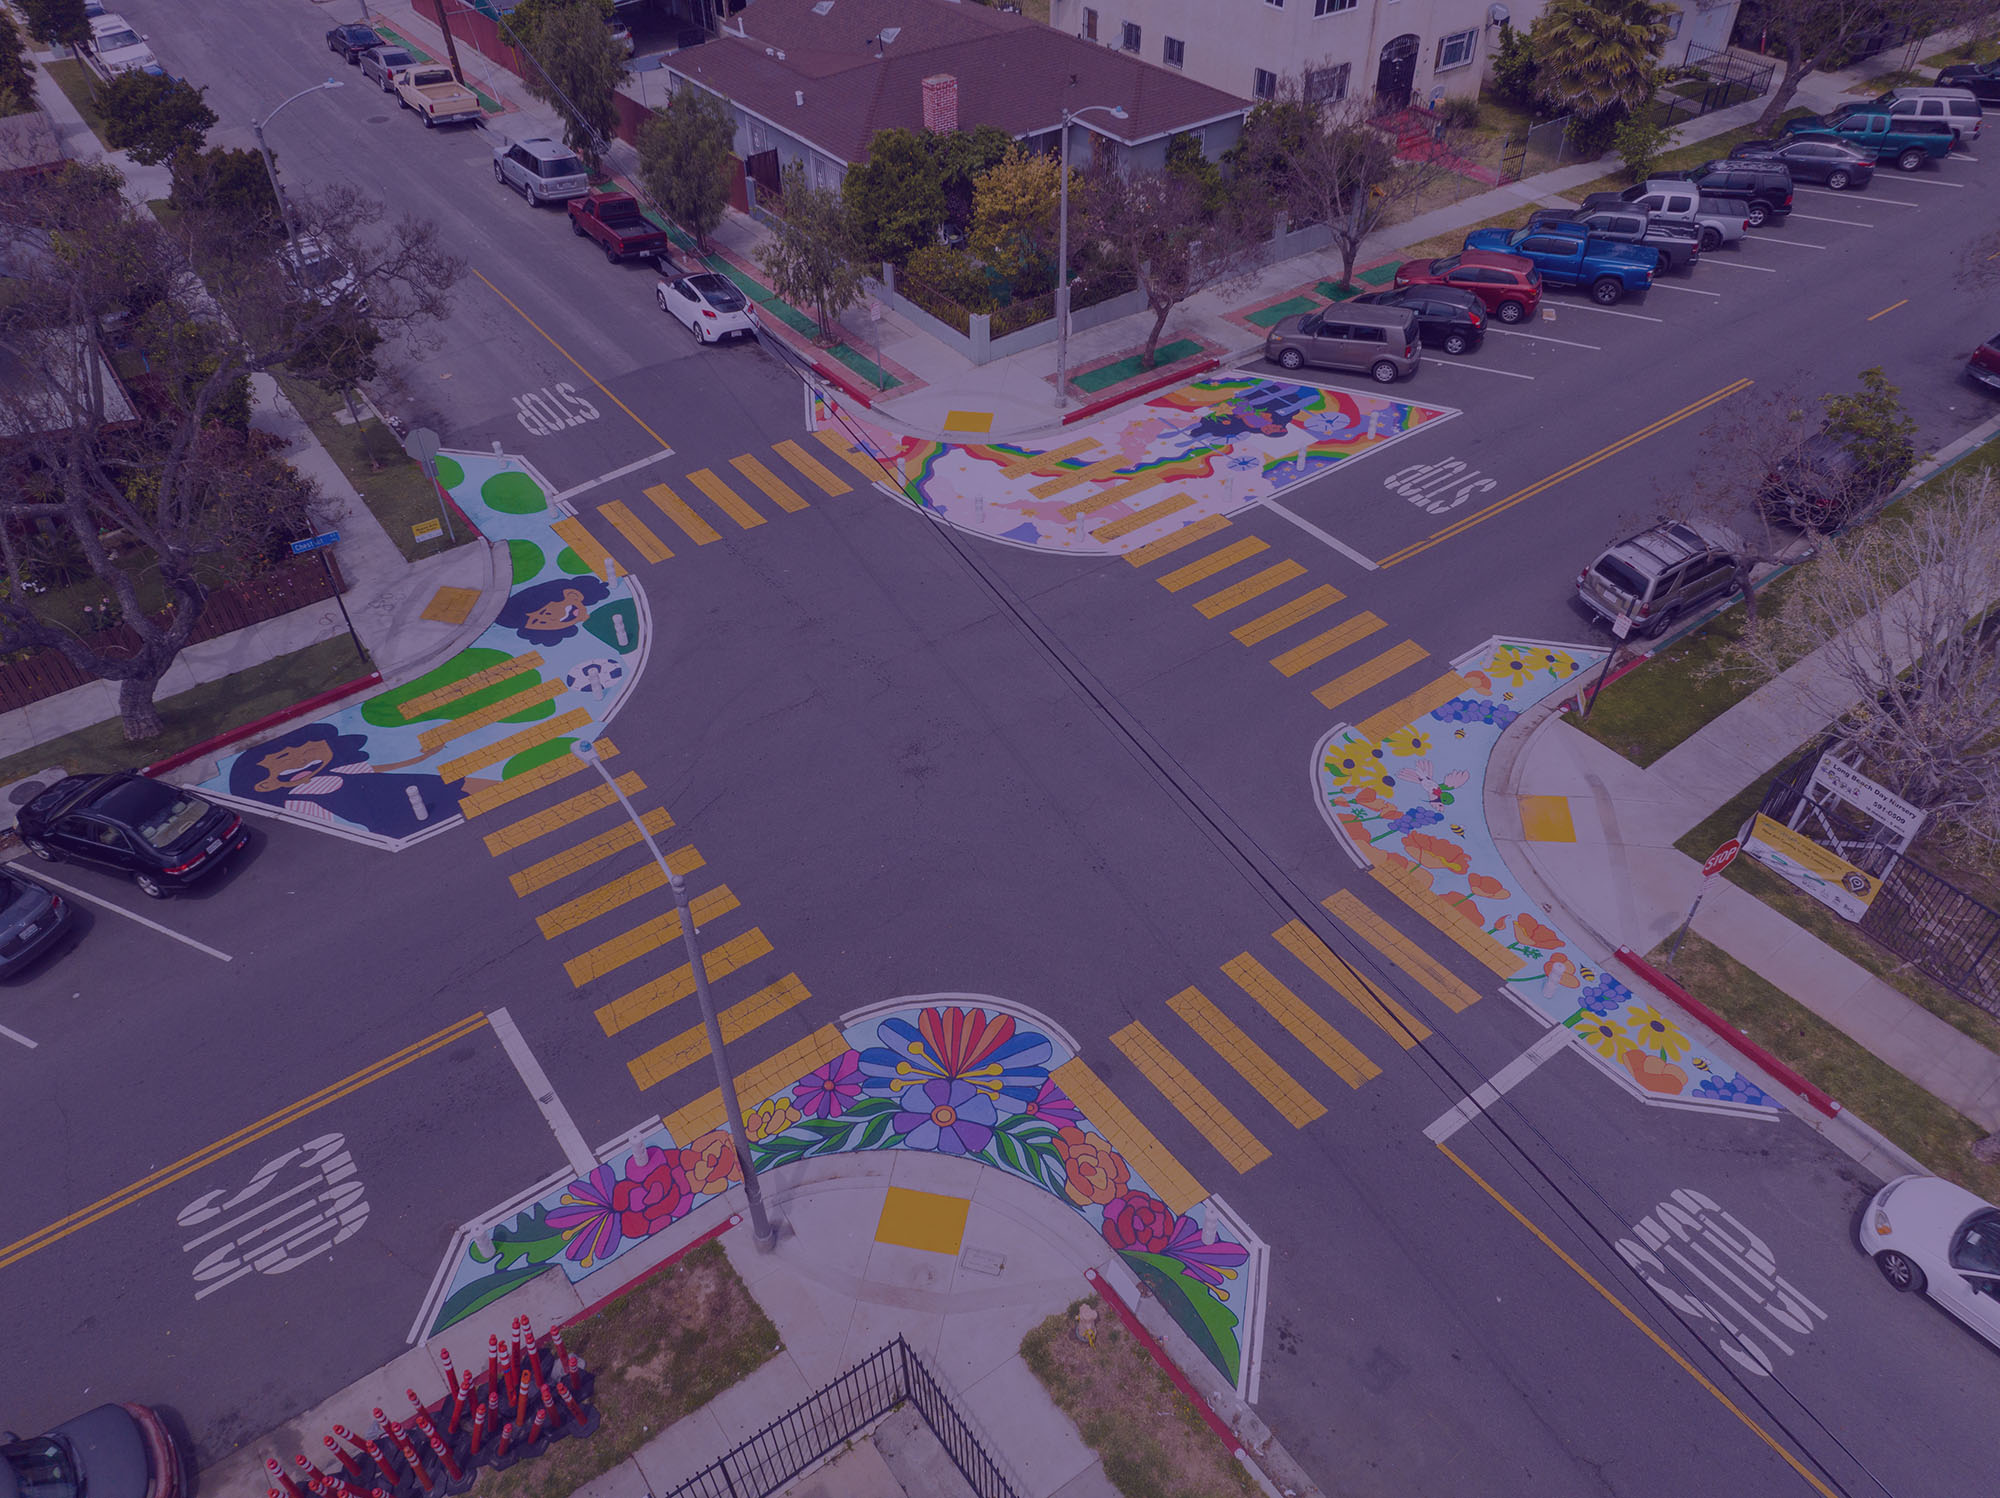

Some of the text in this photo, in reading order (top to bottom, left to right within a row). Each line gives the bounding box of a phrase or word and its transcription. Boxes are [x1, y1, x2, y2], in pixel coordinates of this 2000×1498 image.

[512, 382, 600, 436] STOP
[1384, 456, 1497, 514] STOP
[1833, 763, 1850, 779] Long
[1851, 774, 1873, 792] Beach
[1874, 789, 1888, 803] Day
[1888, 798, 1918, 820] Nursery
[1705, 846, 1737, 870] STOP
[176, 1132, 371, 1301] STOP
[1614, 1188, 1829, 1377] STOP
